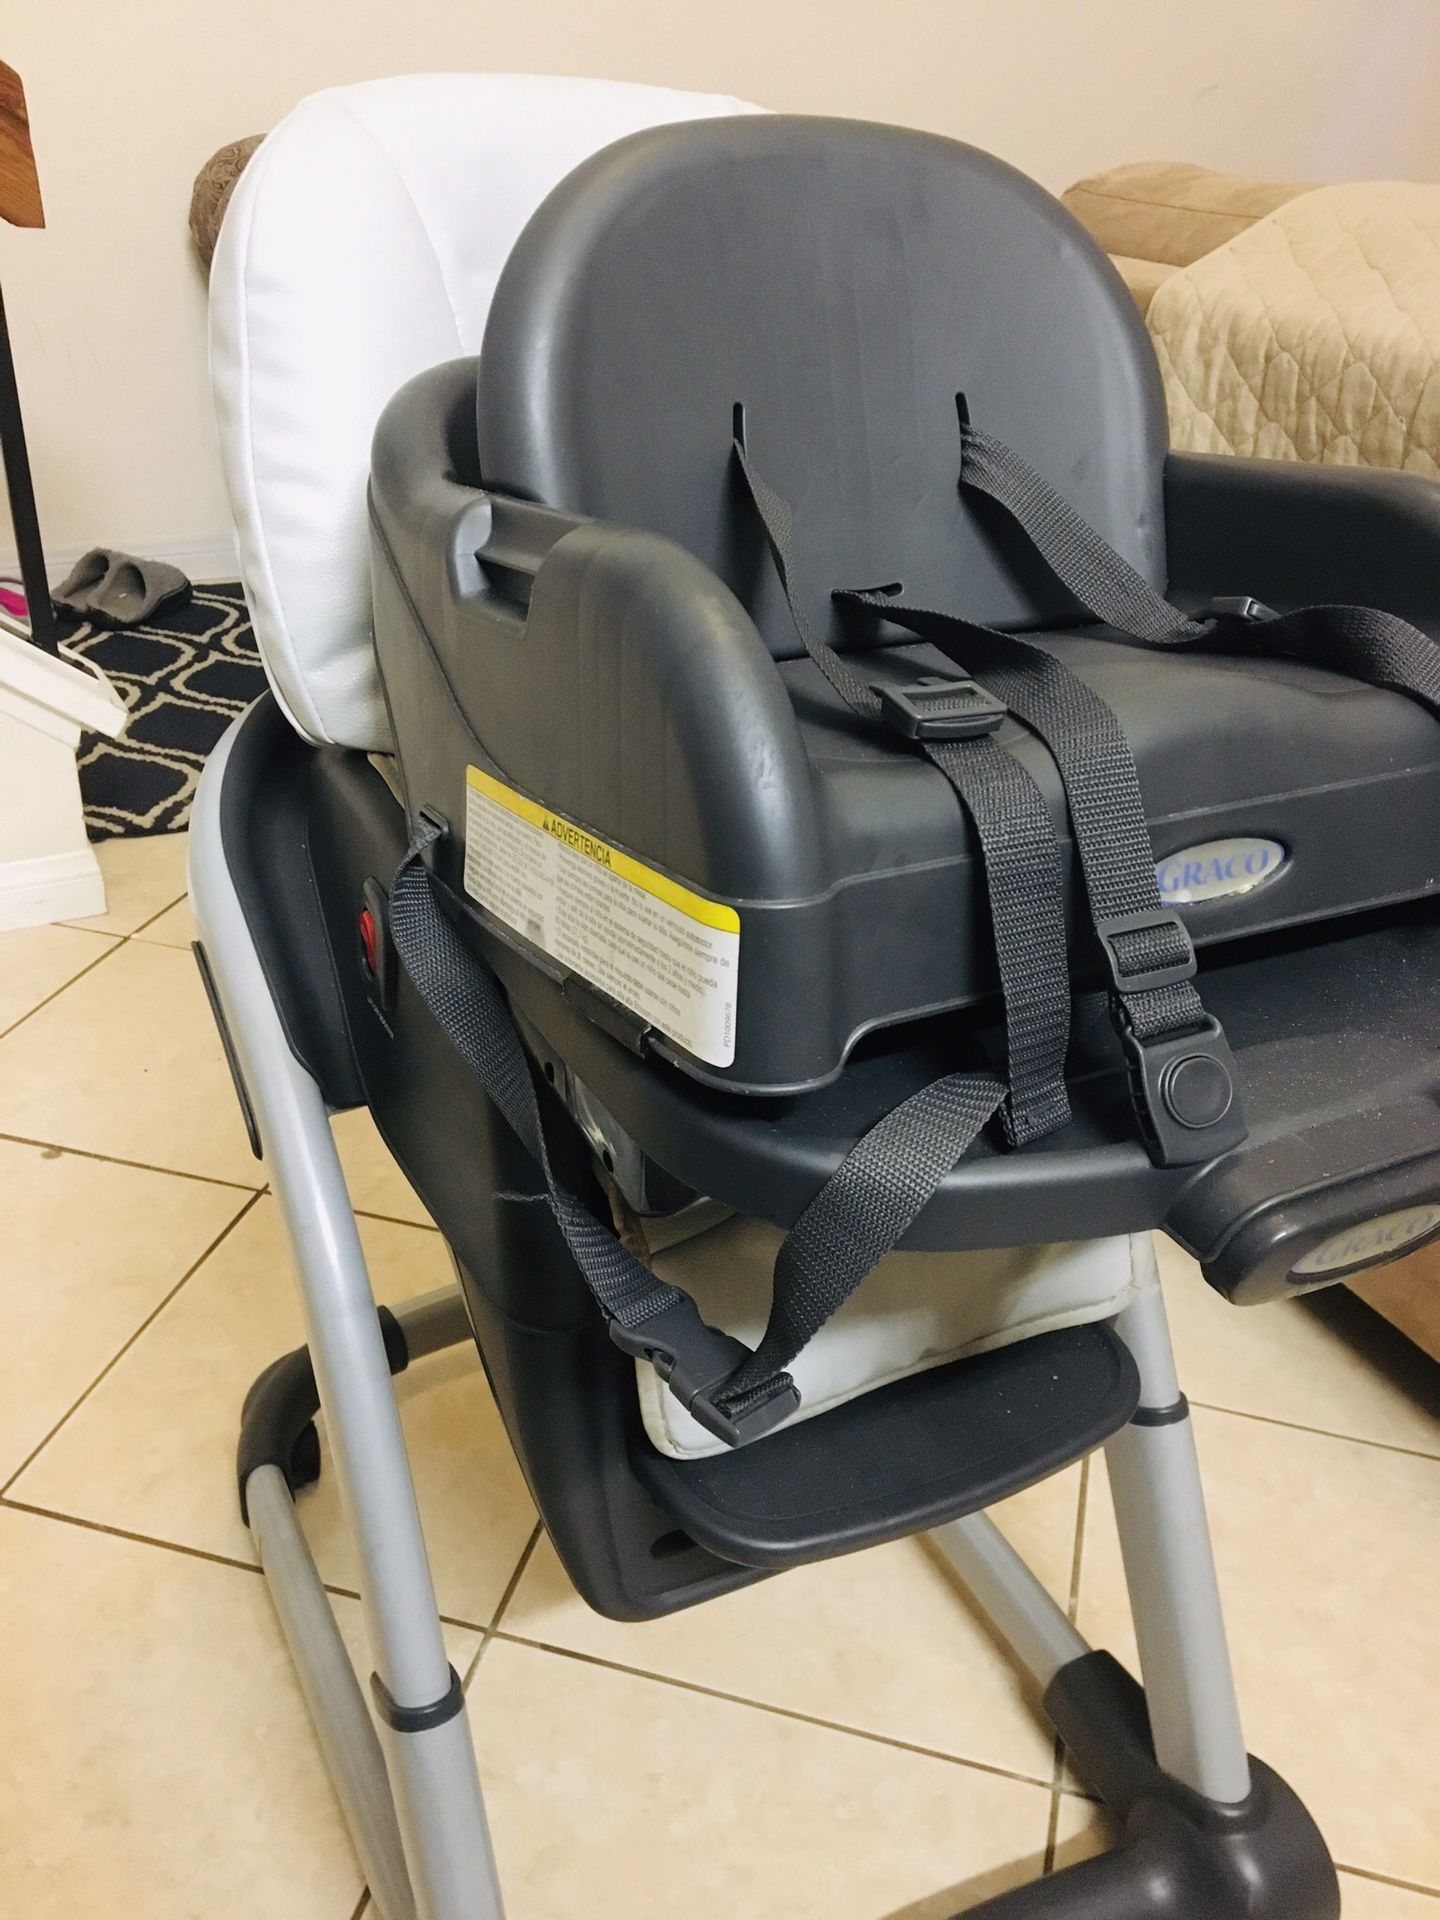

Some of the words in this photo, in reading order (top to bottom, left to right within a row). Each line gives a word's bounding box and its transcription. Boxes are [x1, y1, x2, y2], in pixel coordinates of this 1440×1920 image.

[551, 819, 612, 868] ADVERTENCIA
[1156, 848, 1270, 894] GRACO
[1313, 1210, 1435, 1266] GRACO
